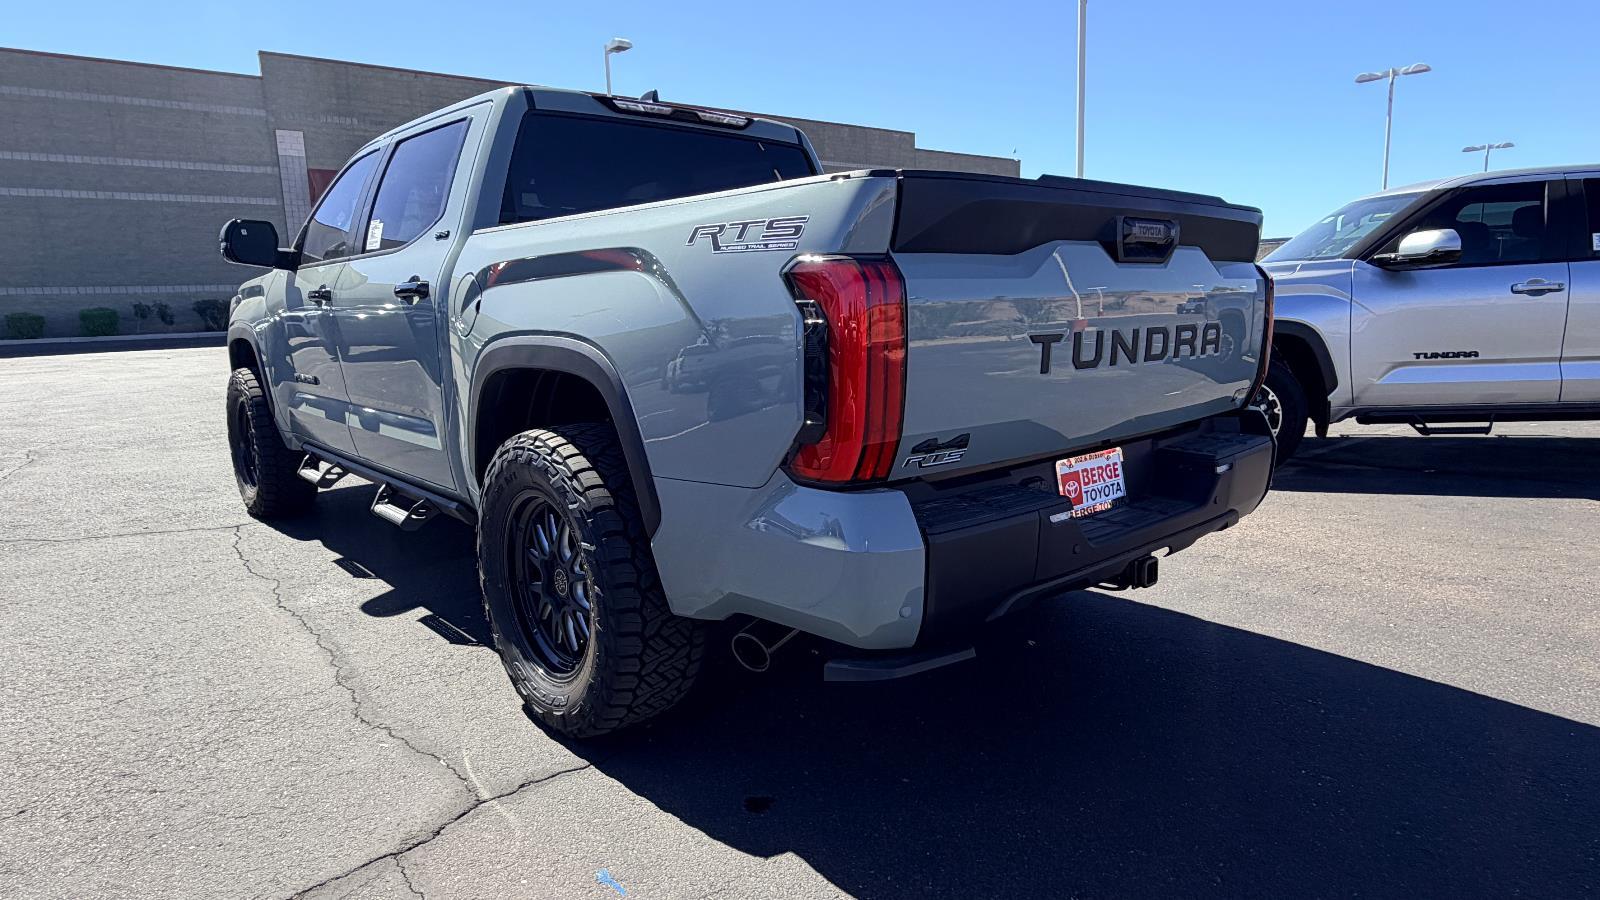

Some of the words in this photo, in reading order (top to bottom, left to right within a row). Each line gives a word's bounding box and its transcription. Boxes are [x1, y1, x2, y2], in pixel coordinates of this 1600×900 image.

[685, 214, 810, 253] RTS
[1028, 320, 1221, 374] TUNDRA
[1413, 351, 1480, 359] TUNDRA
[901, 448, 968, 468] RTS
[1080, 462, 1120, 486] BERGE
[1083, 482, 1123, 503] TOYOTA
